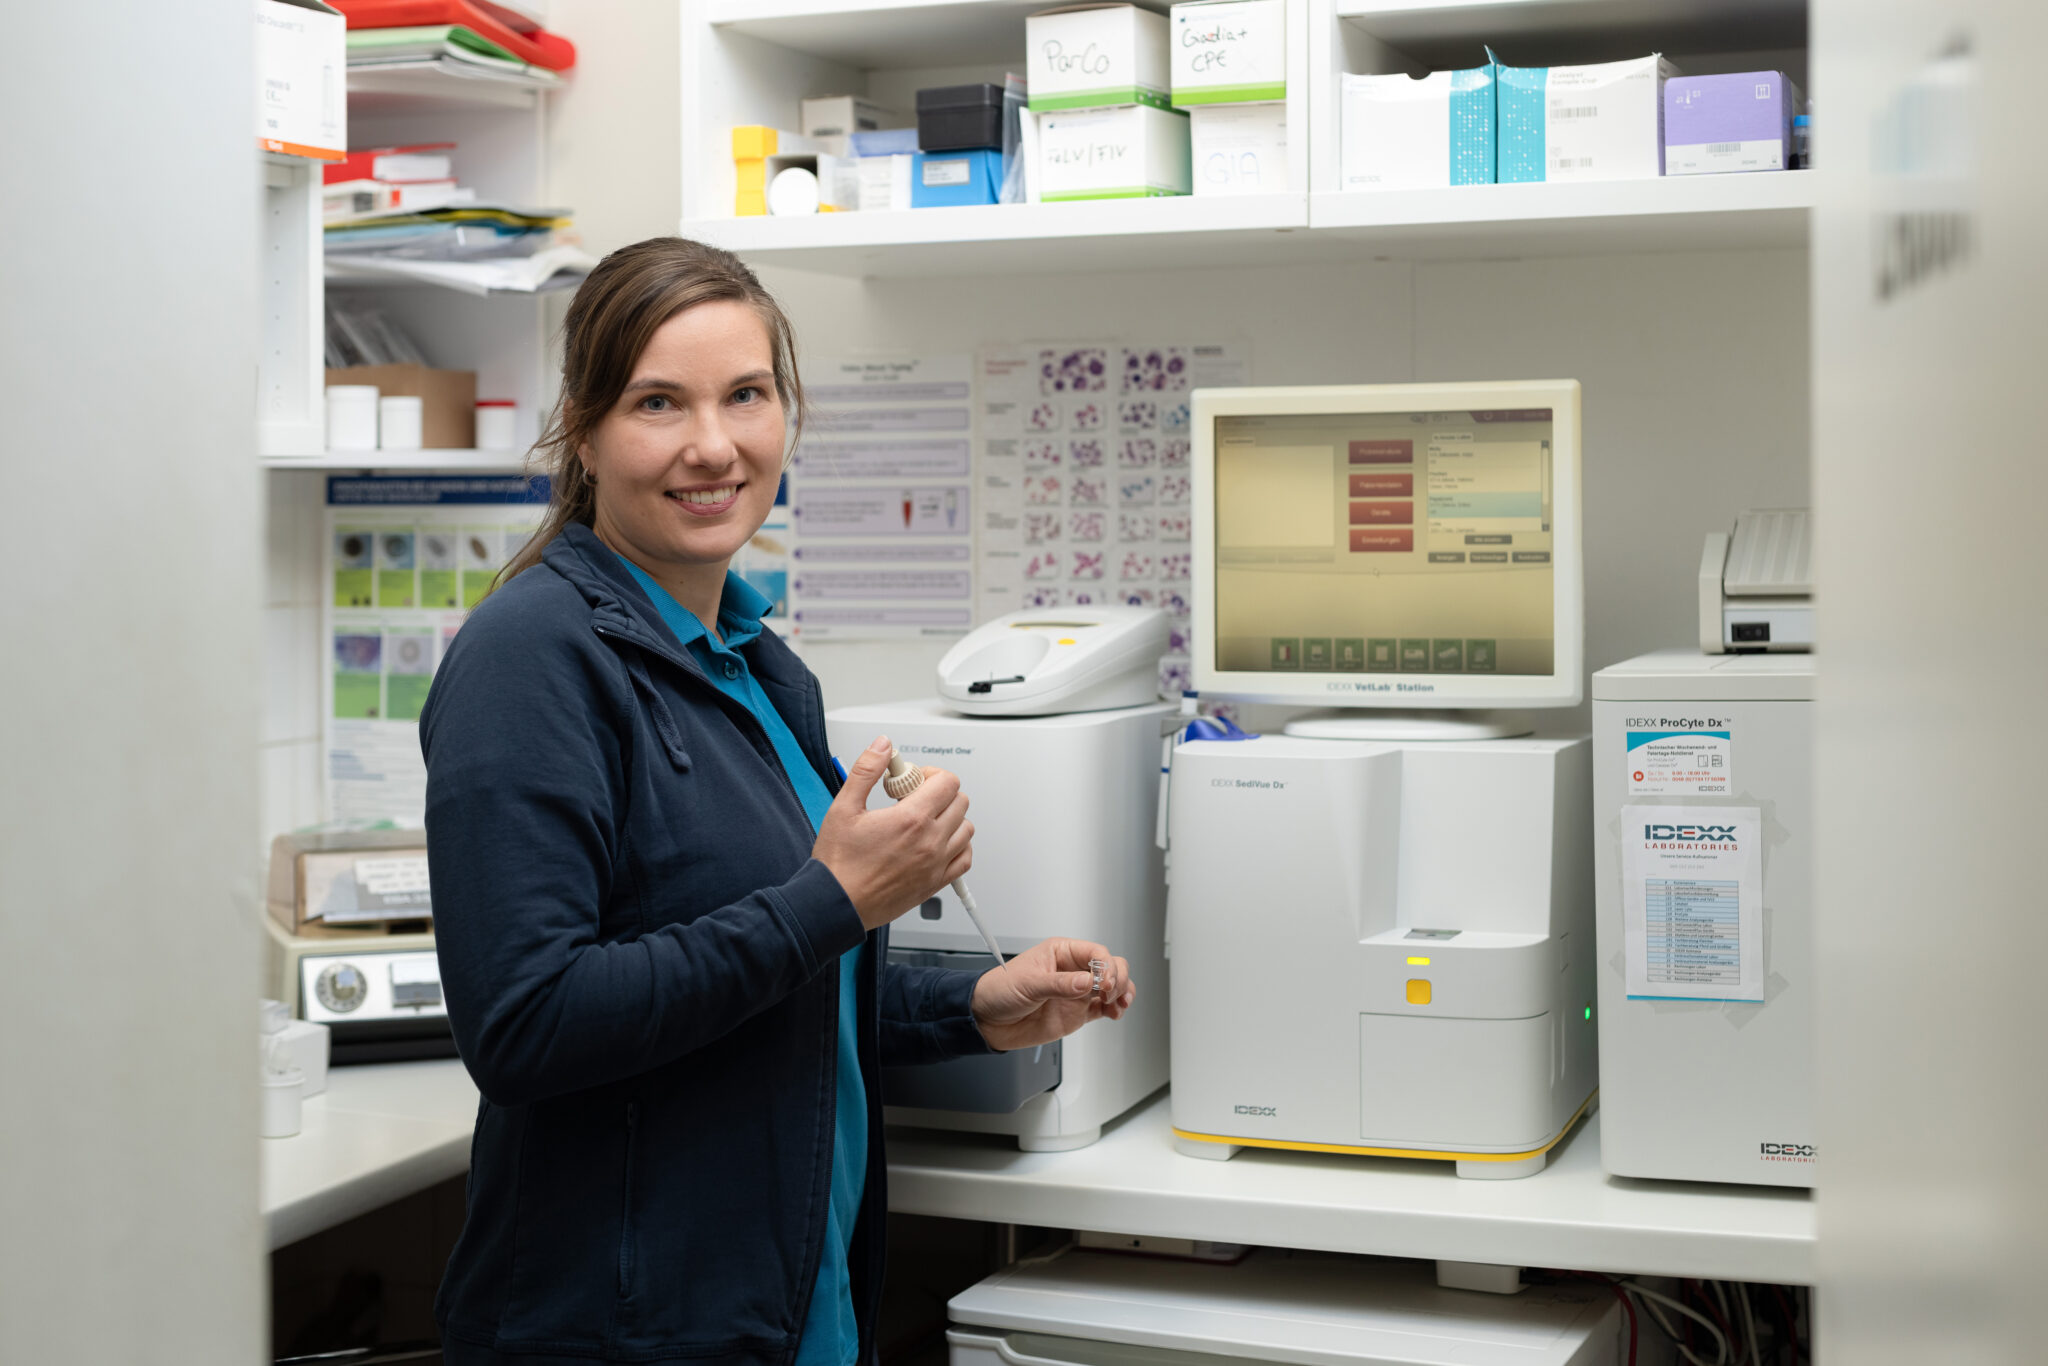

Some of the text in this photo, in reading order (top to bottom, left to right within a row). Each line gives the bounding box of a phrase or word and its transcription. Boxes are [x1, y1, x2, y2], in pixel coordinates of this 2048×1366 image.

[1397, 683, 1434, 692] Station
[1626, 718, 1657, 728] IDEXX
[1660, 718, 1704, 730] ProCyte
[921, 745, 953, 756] Catalyst
[1236, 779, 1270, 789] SediVue
[1645, 824, 1738, 842] IDEXX
[1645, 843, 1739, 852] LABORATORIES
[1234, 1104, 1277, 1117] IDEXX
[1760, 1155, 1818, 1163] LABORATORIE
